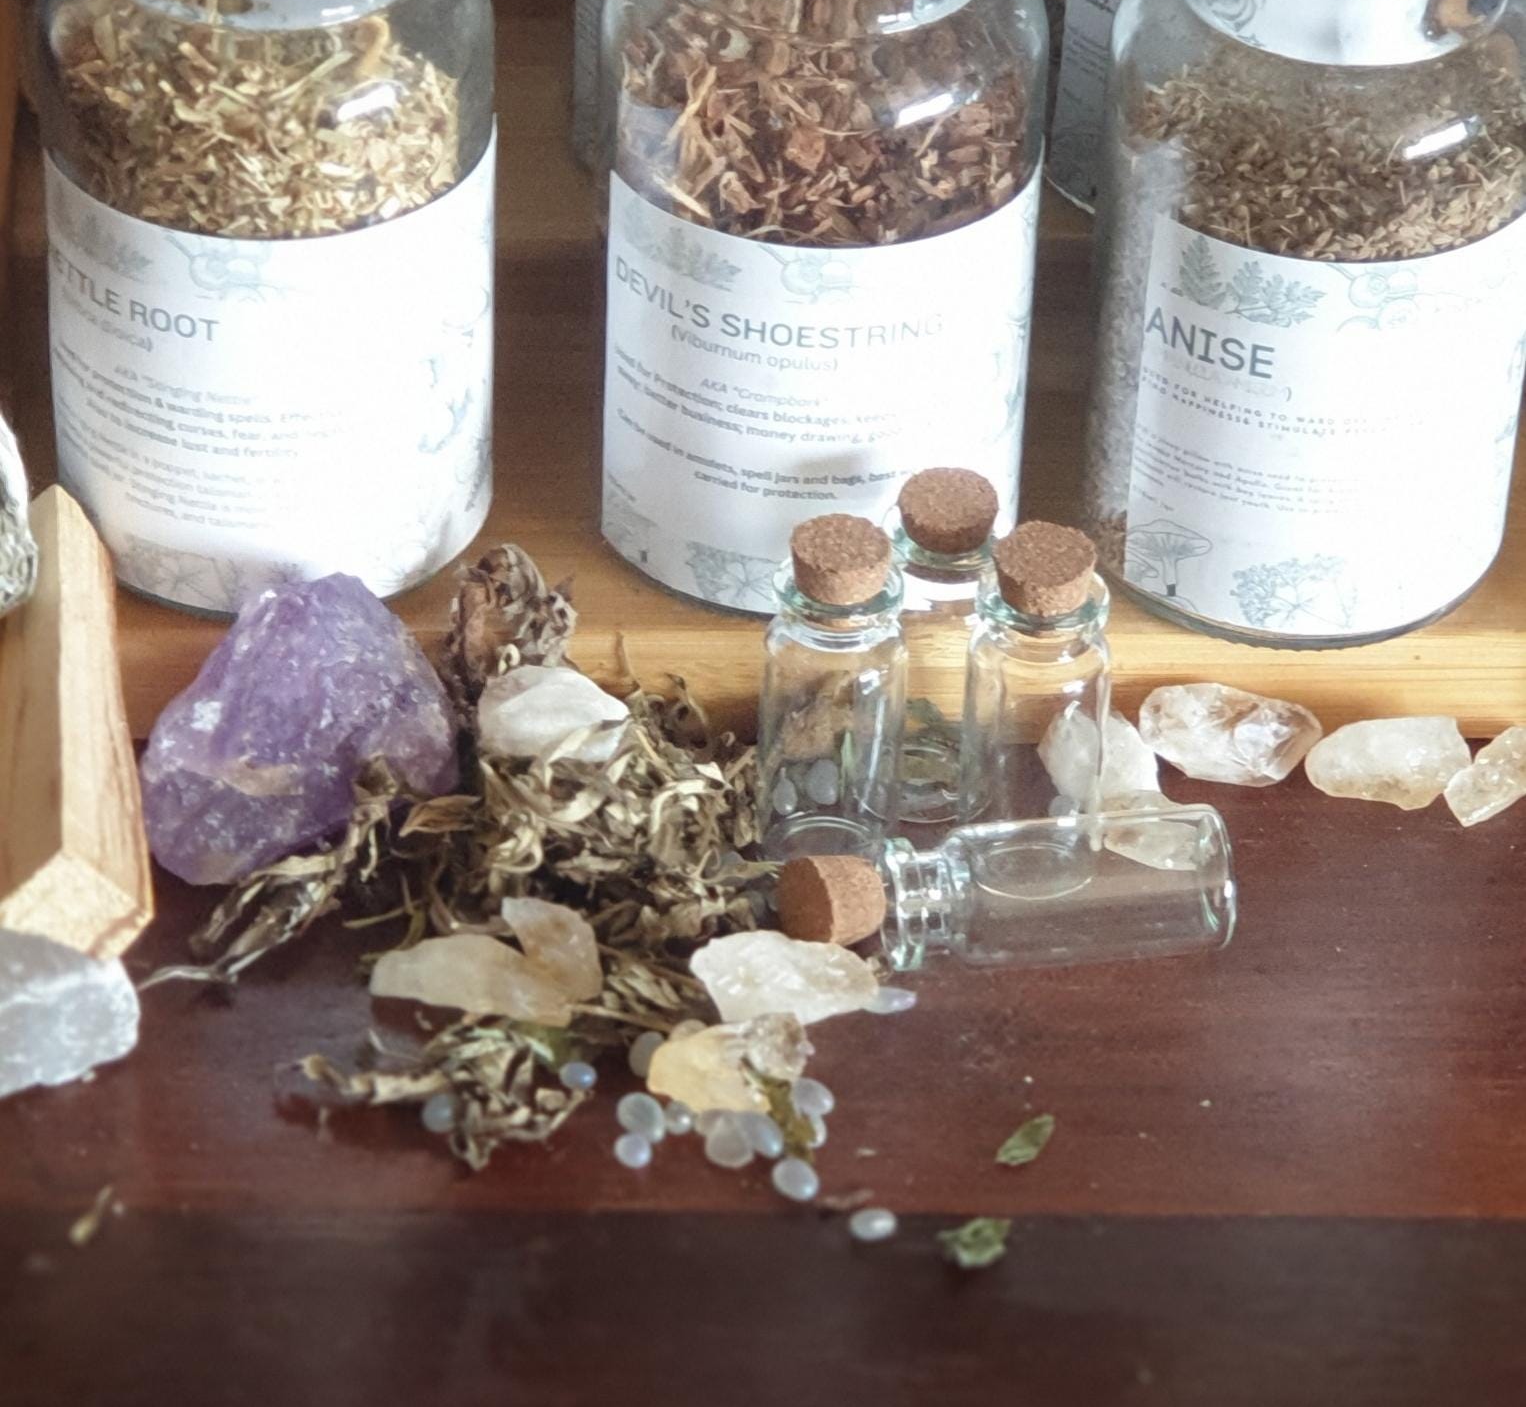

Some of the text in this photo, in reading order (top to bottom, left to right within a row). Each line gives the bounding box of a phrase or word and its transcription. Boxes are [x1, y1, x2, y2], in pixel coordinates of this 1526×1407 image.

[53, 247, 122, 316] ETTLE
[129, 298, 220, 341] ROOT
[616, 255, 943, 350] DEVIL'S SHOESTRING
[671, 323, 839, 372] (Viburnum opulus)
[1145, 306, 1276, 380] ANISE
[700, 377, 729, 395] AKA
[166, 402, 224, 424] warding
[726, 403, 769, 421] clears
[1173, 383, 1197, 399] FOR
[1203, 395, 1263, 418] HELPING
[1270, 412, 1288, 423] TO
[1296, 416, 1335, 427] WARD
[124, 421, 178, 447] increase
[746, 425, 796, 443] money
[693, 469, 739, 490] carried
[740, 481, 761, 494] for
[740, 467, 773, 483] spell
[774, 471, 800, 485] jars
[802, 474, 829, 486] and
